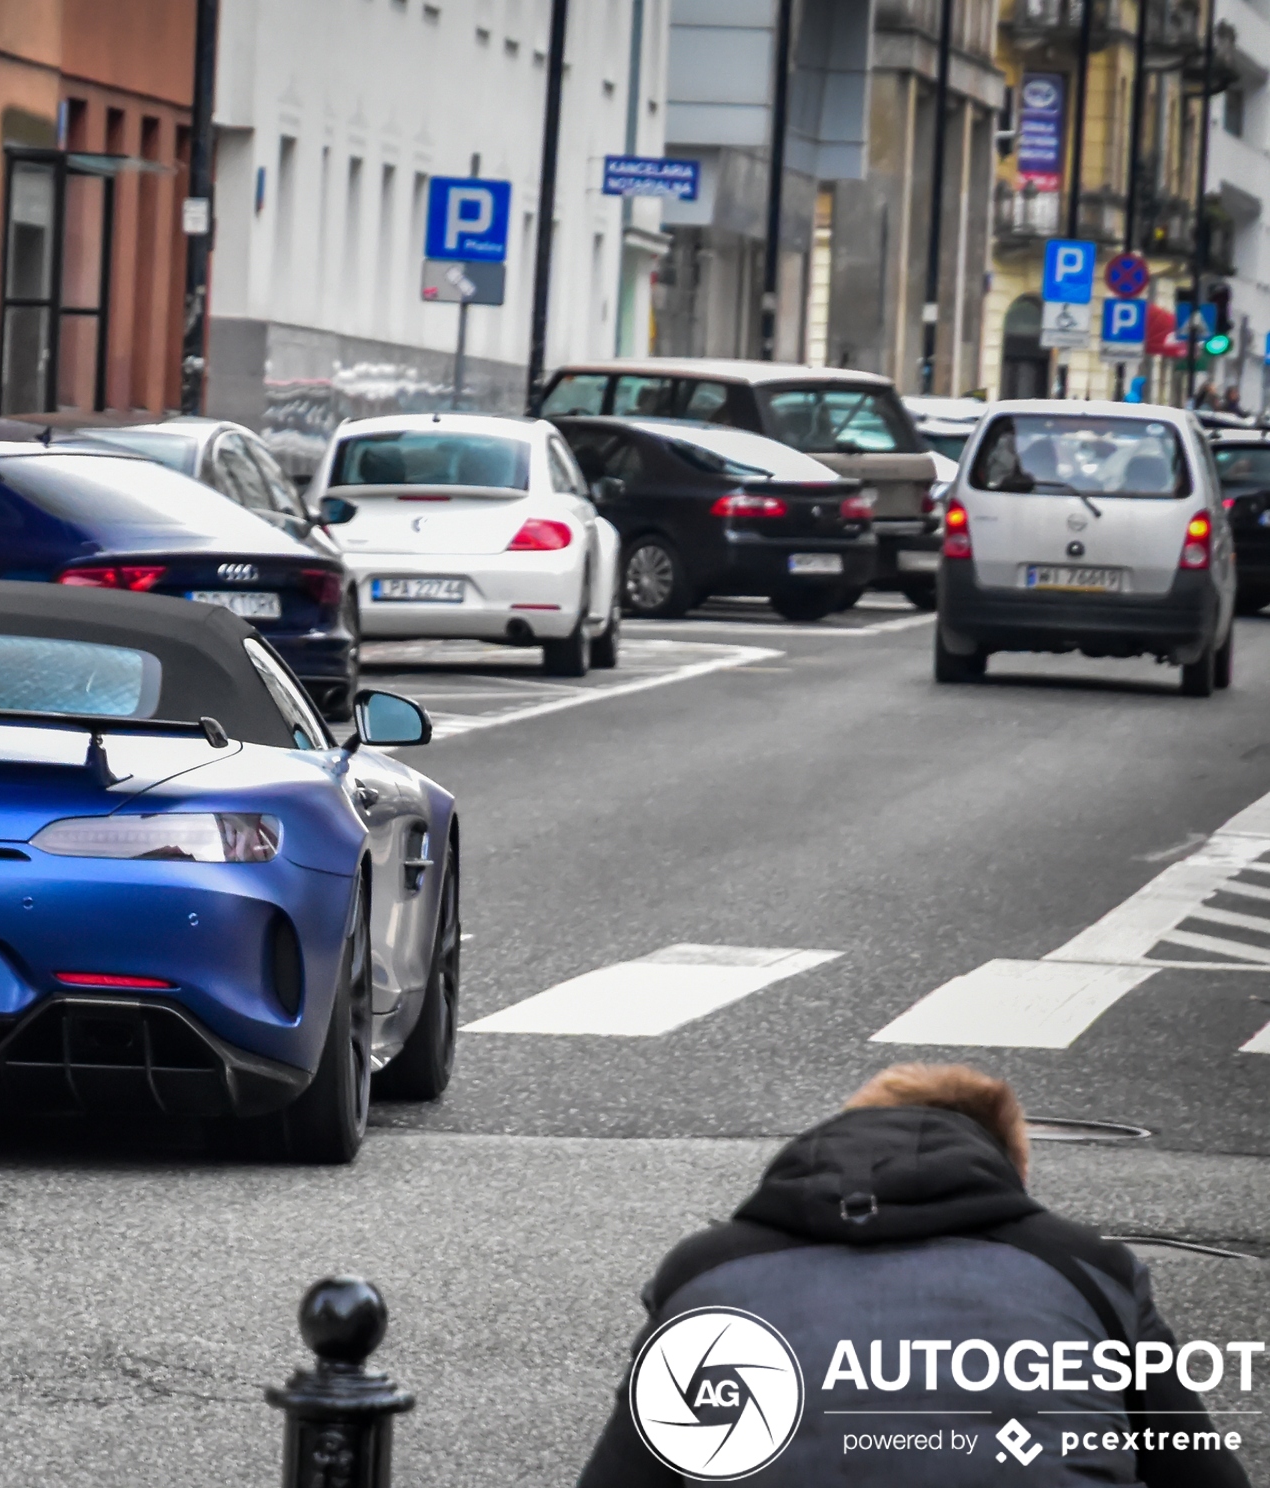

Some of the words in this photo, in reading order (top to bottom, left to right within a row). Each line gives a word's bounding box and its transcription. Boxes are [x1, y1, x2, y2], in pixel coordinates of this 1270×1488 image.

[608, 160, 694, 178] KANCELARIA
[607, 177, 692, 196] NOTARIALNA
[444, 186, 493, 250] P
[1055, 247, 1084, 283] P
[1111, 303, 1138, 336] P
